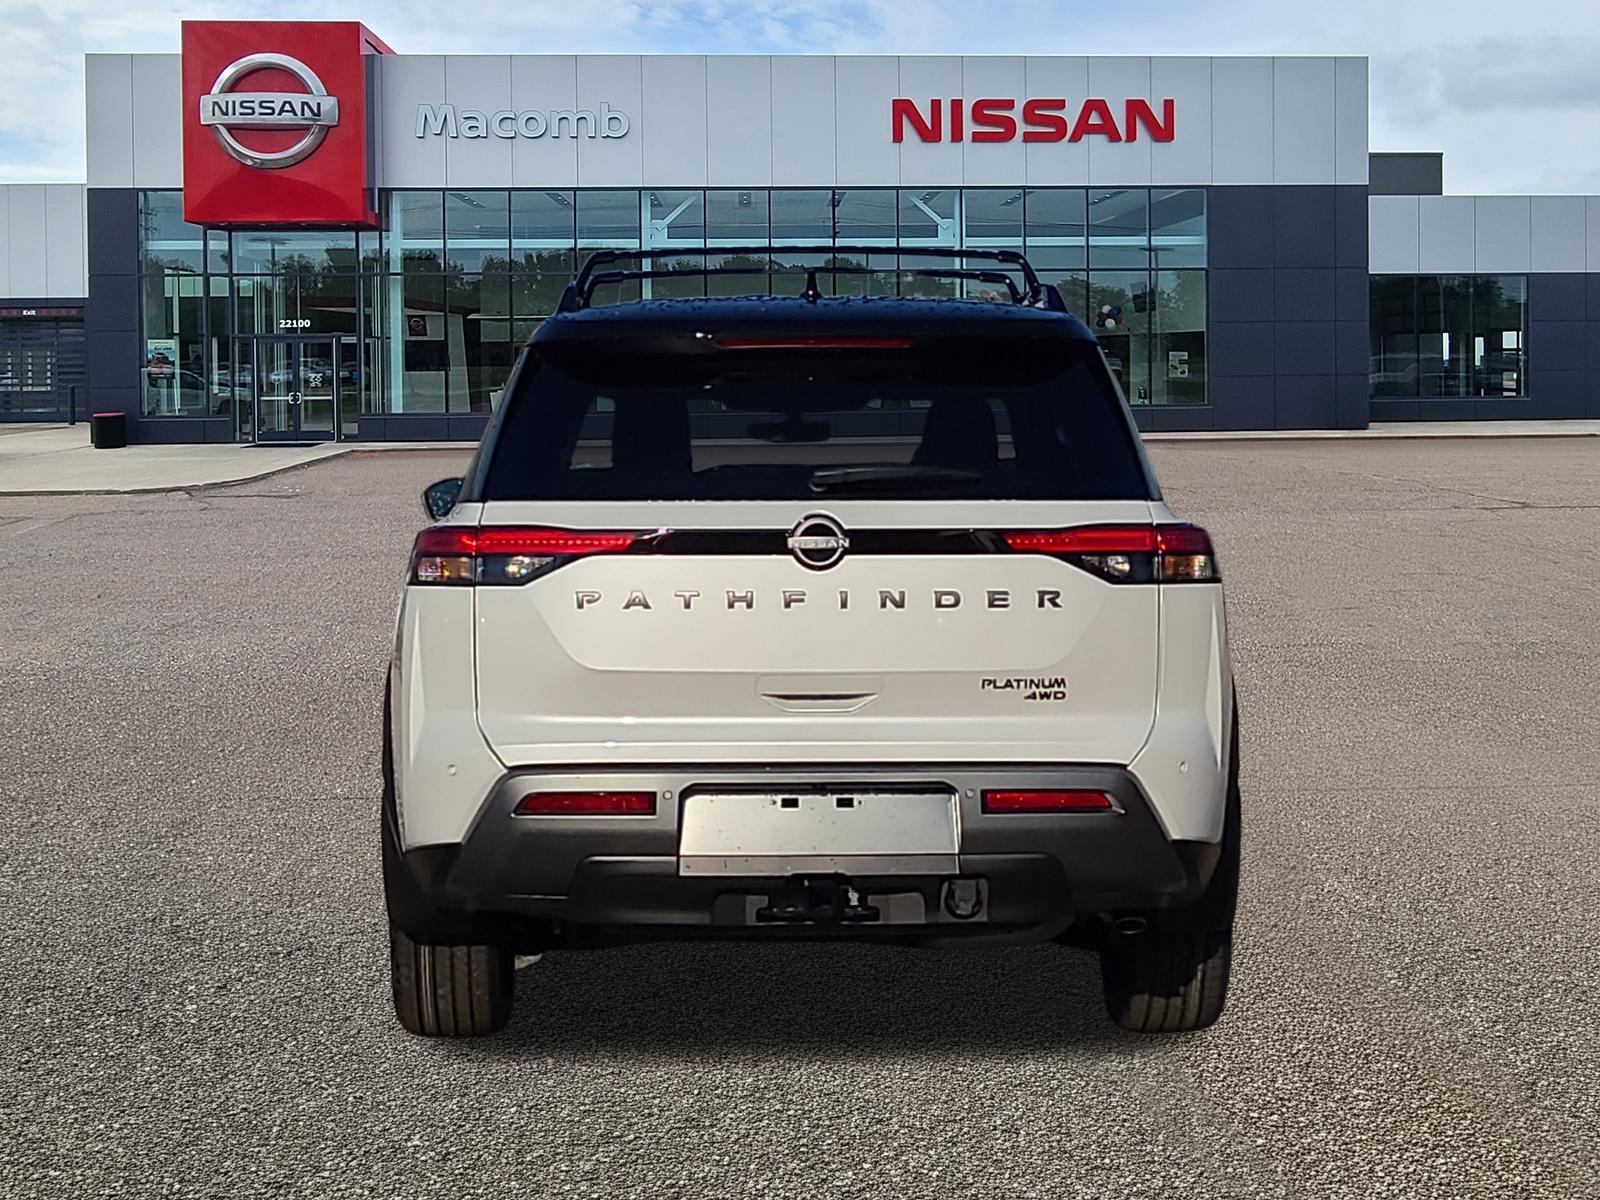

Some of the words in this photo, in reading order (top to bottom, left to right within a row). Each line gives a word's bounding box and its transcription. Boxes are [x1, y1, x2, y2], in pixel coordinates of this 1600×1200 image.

[212, 100, 322, 118] NISSAN
[415, 101, 631, 139] Macomb
[892, 98, 1176, 143] NISSAN
[279, 319, 311, 328] 22100
[575, 590, 1062, 610] PATHFINDER
[981, 677, 1066, 690] PLATINUM
[1023, 690, 1066, 701] 4WD
